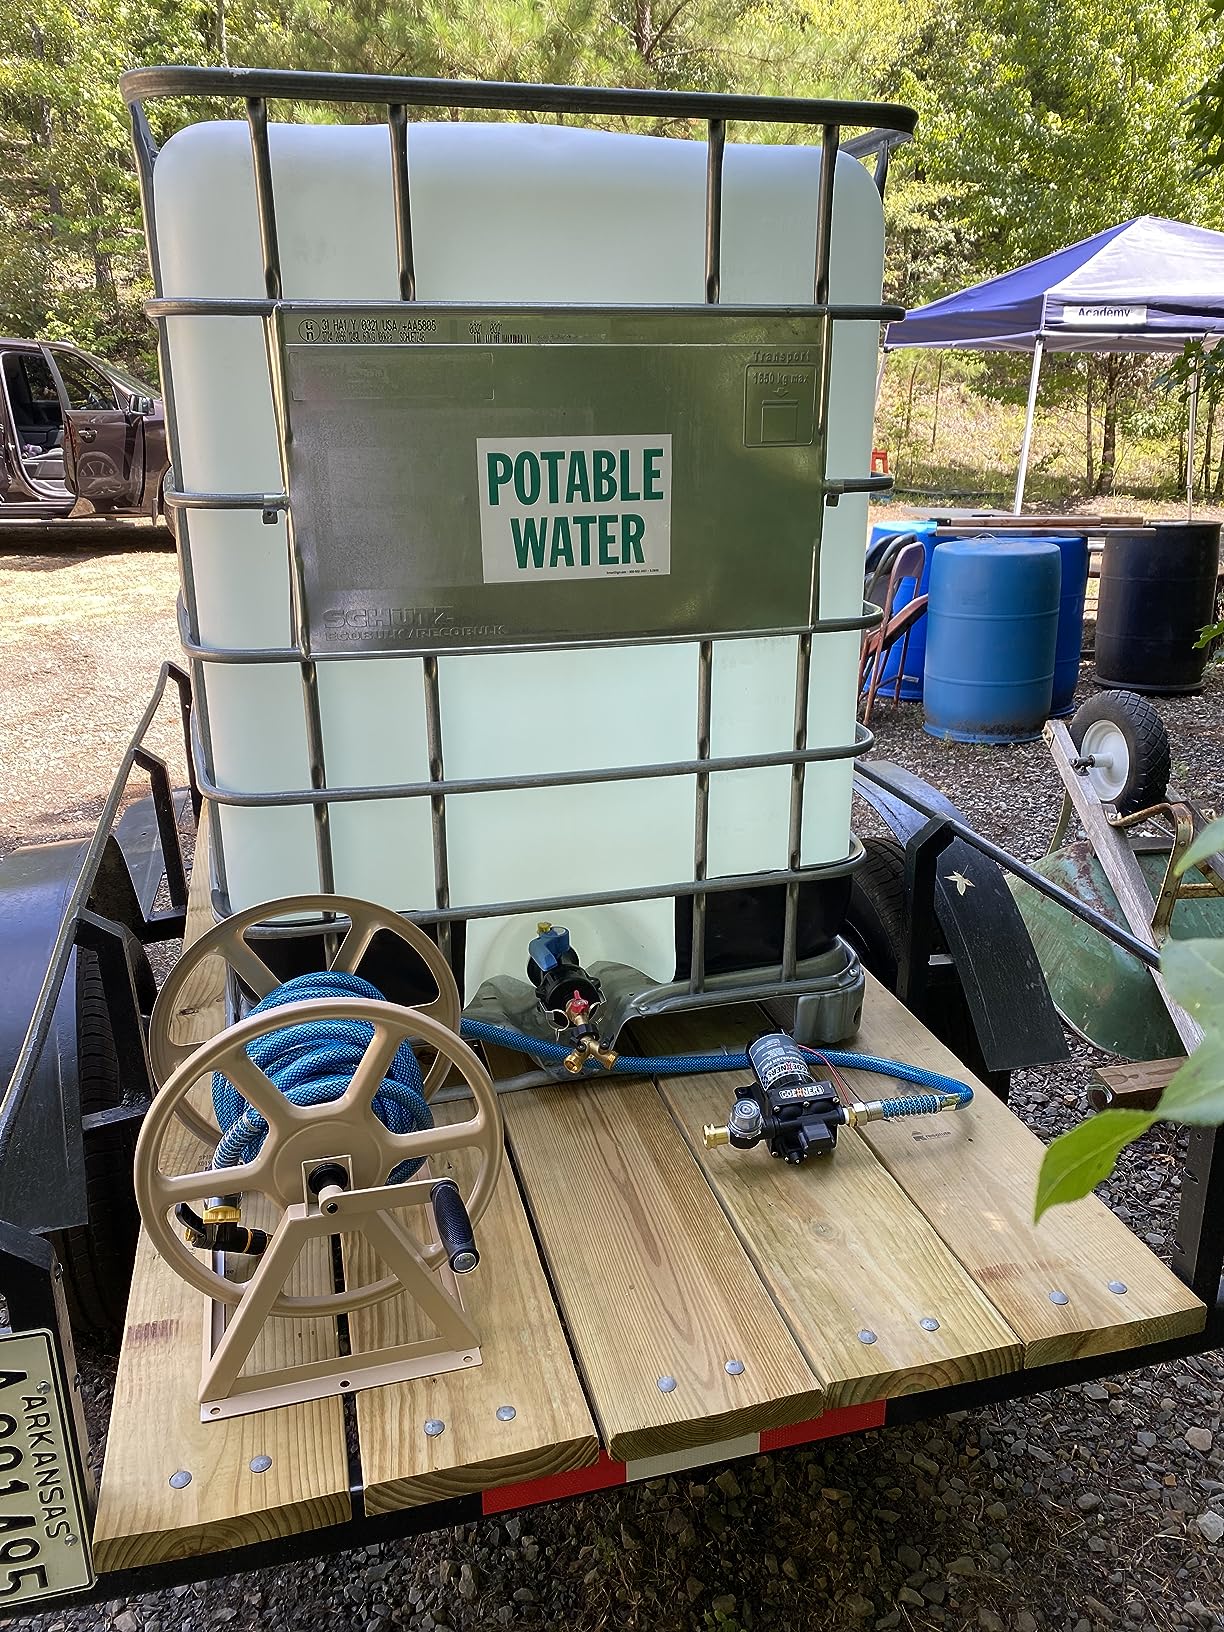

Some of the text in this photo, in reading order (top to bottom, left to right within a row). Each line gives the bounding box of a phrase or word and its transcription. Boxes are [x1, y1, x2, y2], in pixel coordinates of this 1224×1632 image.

[1078, 306, 1131, 317] Academy
[752, 350, 810, 363] Transport
[752, 372, 809, 386] 1650 kg max
[486, 447, 665, 506] POTABLE
[509, 513, 646, 569] WATER
[20, 1396, 71, 1539] ARKANSAS
